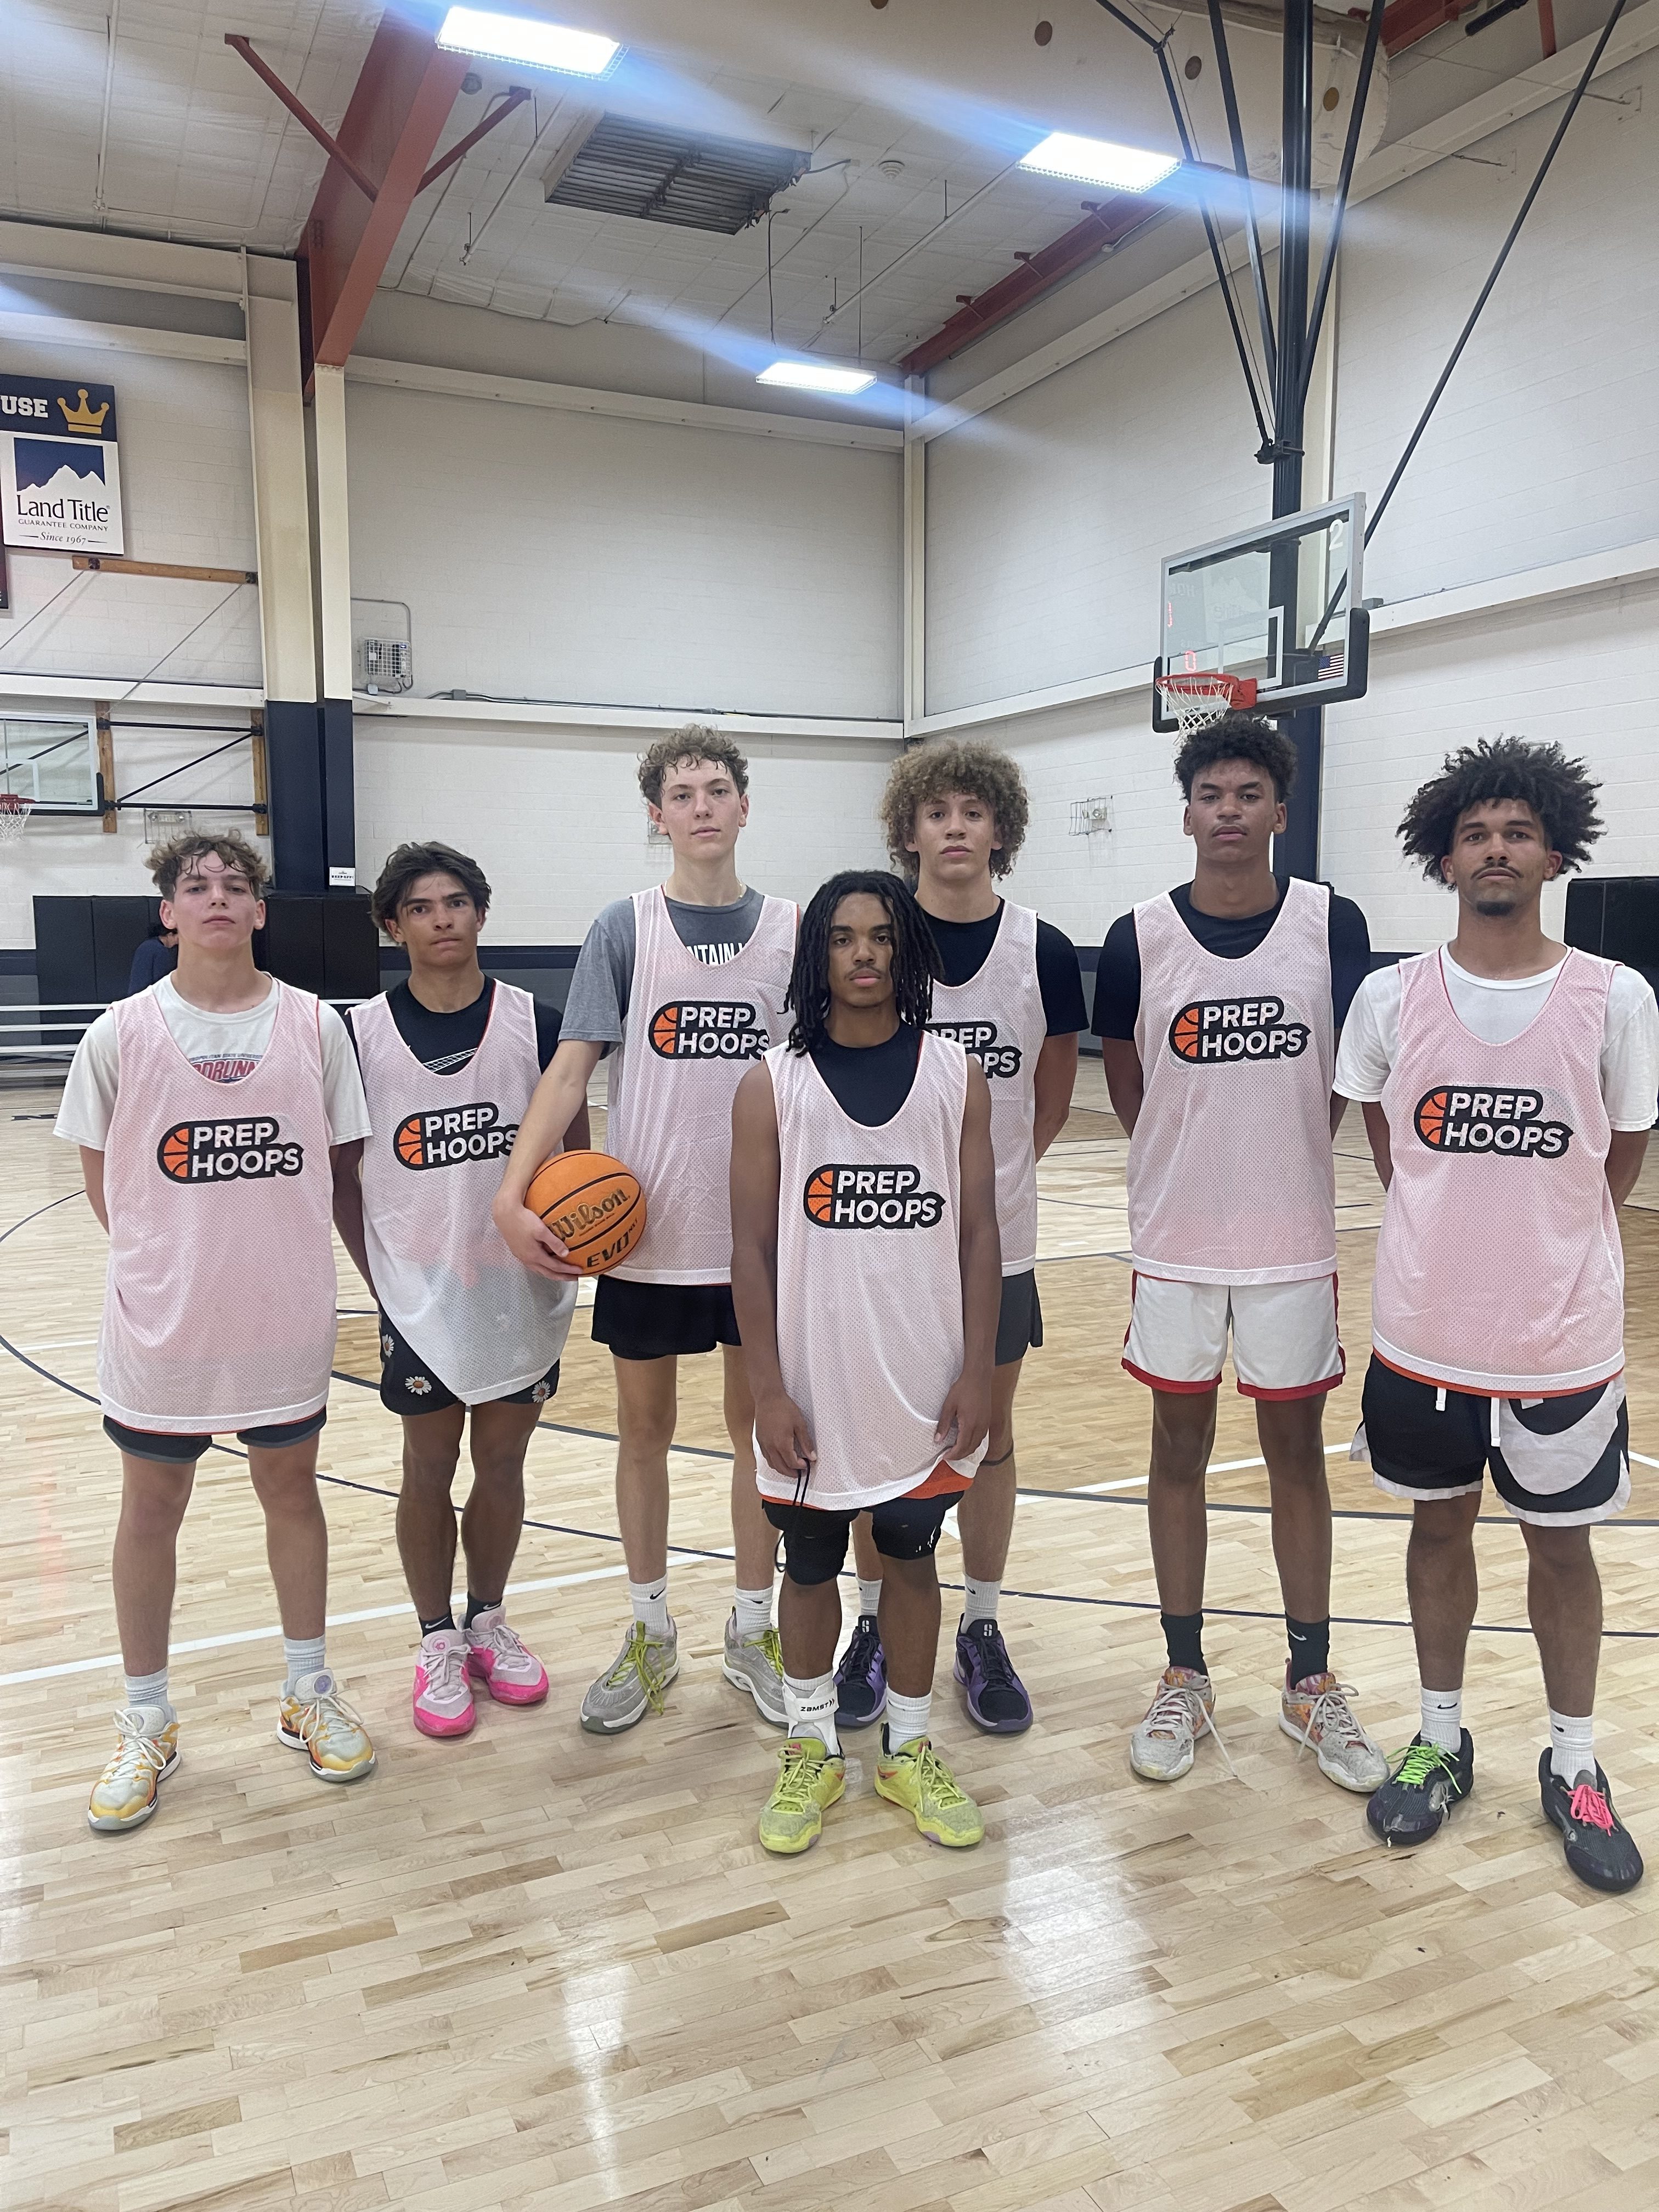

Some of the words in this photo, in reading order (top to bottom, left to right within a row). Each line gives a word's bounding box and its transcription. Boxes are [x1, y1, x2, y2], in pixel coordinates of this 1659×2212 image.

[17, 494, 64, 518] Land
[67, 499, 108, 522] Title
[18, 518, 66, 528] GUARANTEE
[70, 523, 108, 531] COMPANY
[40, 531, 63, 541] Since
[66, 535, 86, 545] 1967
[1329, 518, 1344, 550] 2
[680, 1006, 751, 1029] PREP
[1203, 1002, 1279, 1029] PREP
[678, 1032, 769, 1054] HOOPS
[932, 1026, 992, 1048] REP
[1202, 1029, 1303, 1058] HOOPS
[1449, 1092, 1537, 1120] PREP
[193, 1122, 274, 1150] PREP
[425, 1107, 494, 1138] PREP
[426, 1129, 519, 1164] HOOPS
[1444, 1122, 1565, 1152] HOOPS
[191, 1148, 300, 1178] HOOPS
[837, 1170, 915, 1194] PREP
[547, 1188, 628, 1243] Wilson
[834, 1198, 938, 1223] HOOPS
[586, 1232, 629, 1268] EVO
